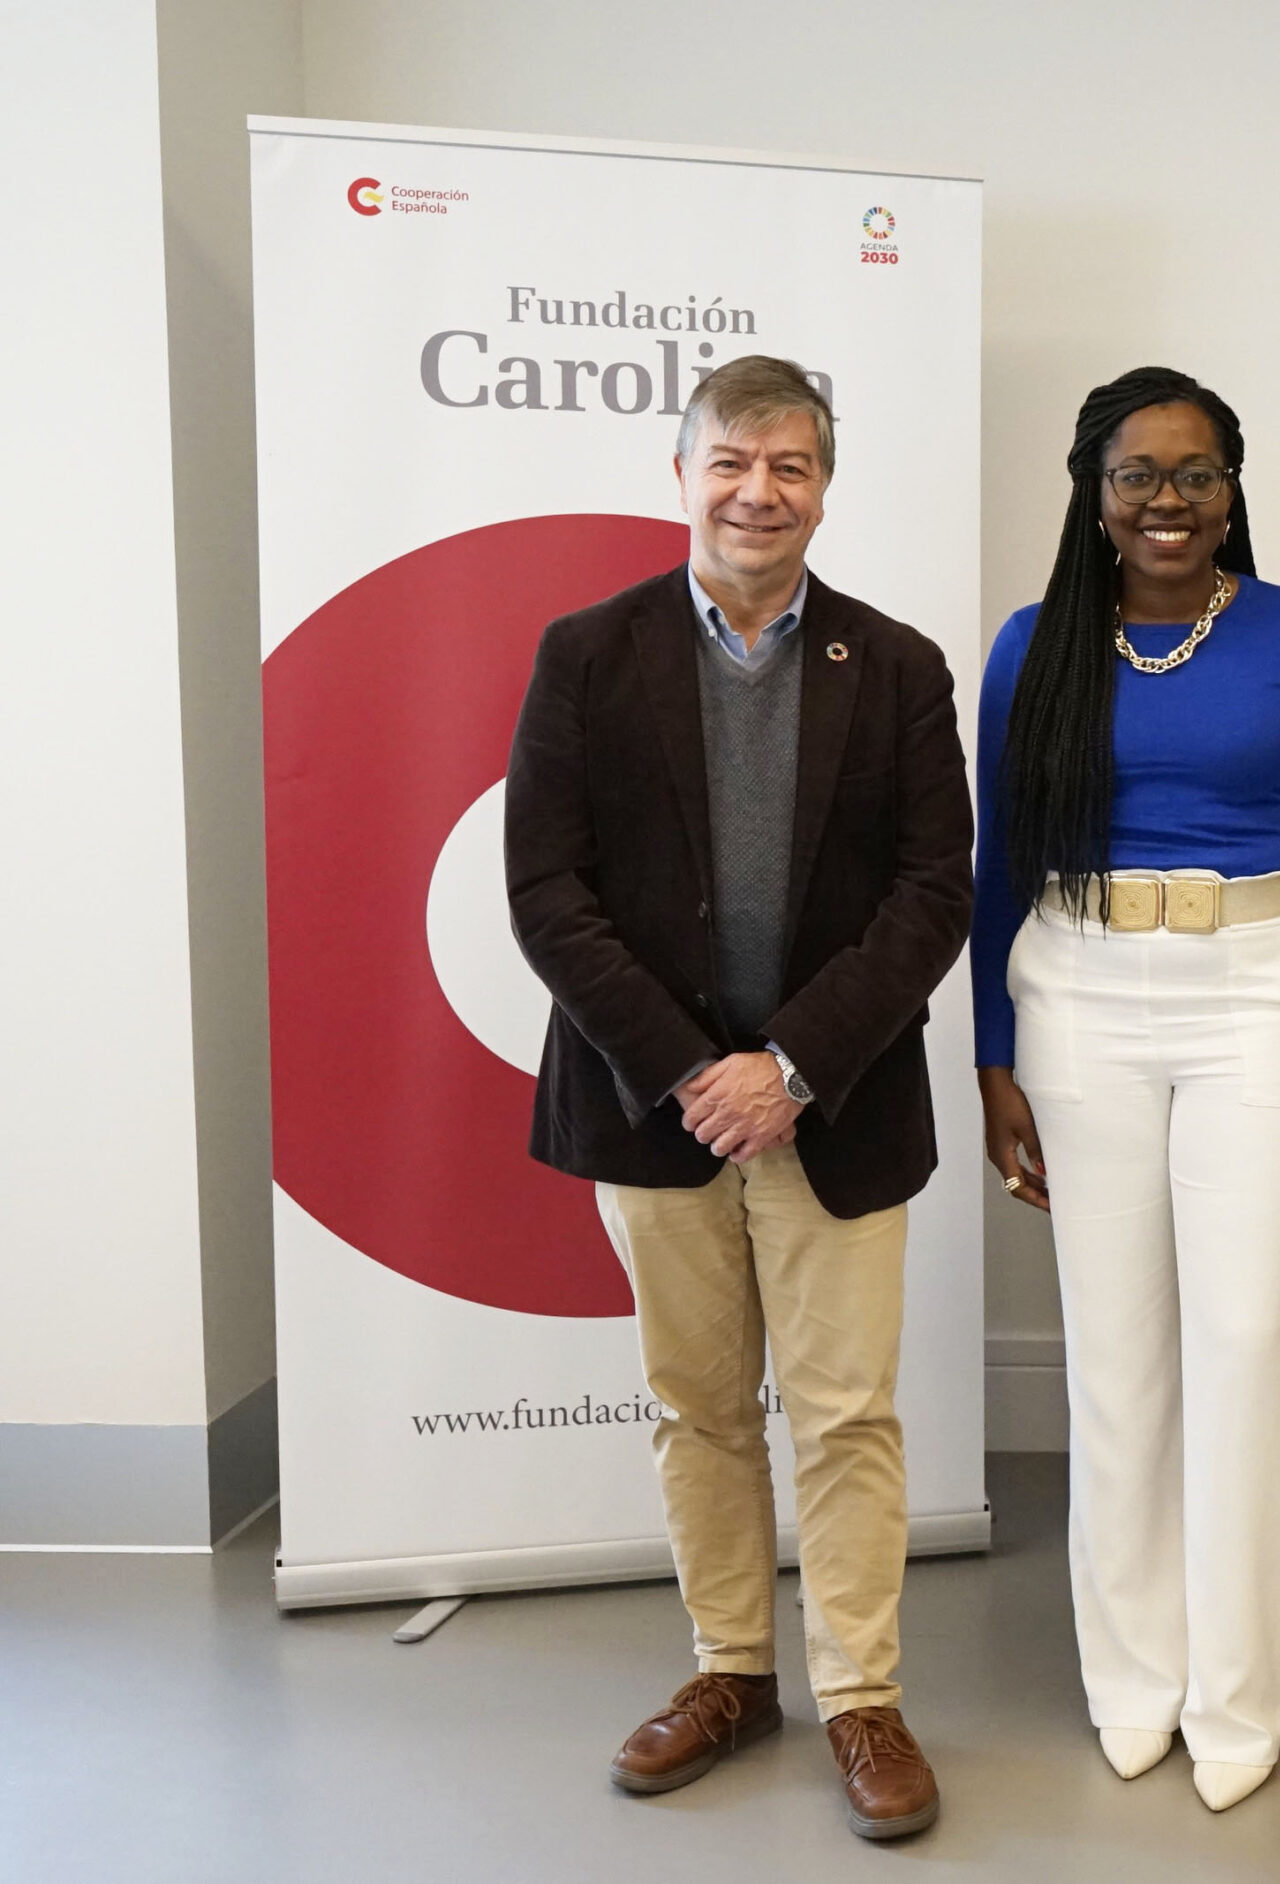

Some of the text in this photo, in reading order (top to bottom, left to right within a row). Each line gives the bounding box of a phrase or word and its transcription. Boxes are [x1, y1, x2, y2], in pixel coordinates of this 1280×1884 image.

[391, 186, 469, 200] Cooperación
[392, 200, 447, 214] Española
[860, 242, 899, 252] AGENDA
[860, 251, 899, 265] 2030
[506, 285, 758, 336] Fundación
[419, 329, 841, 422] Caroli
